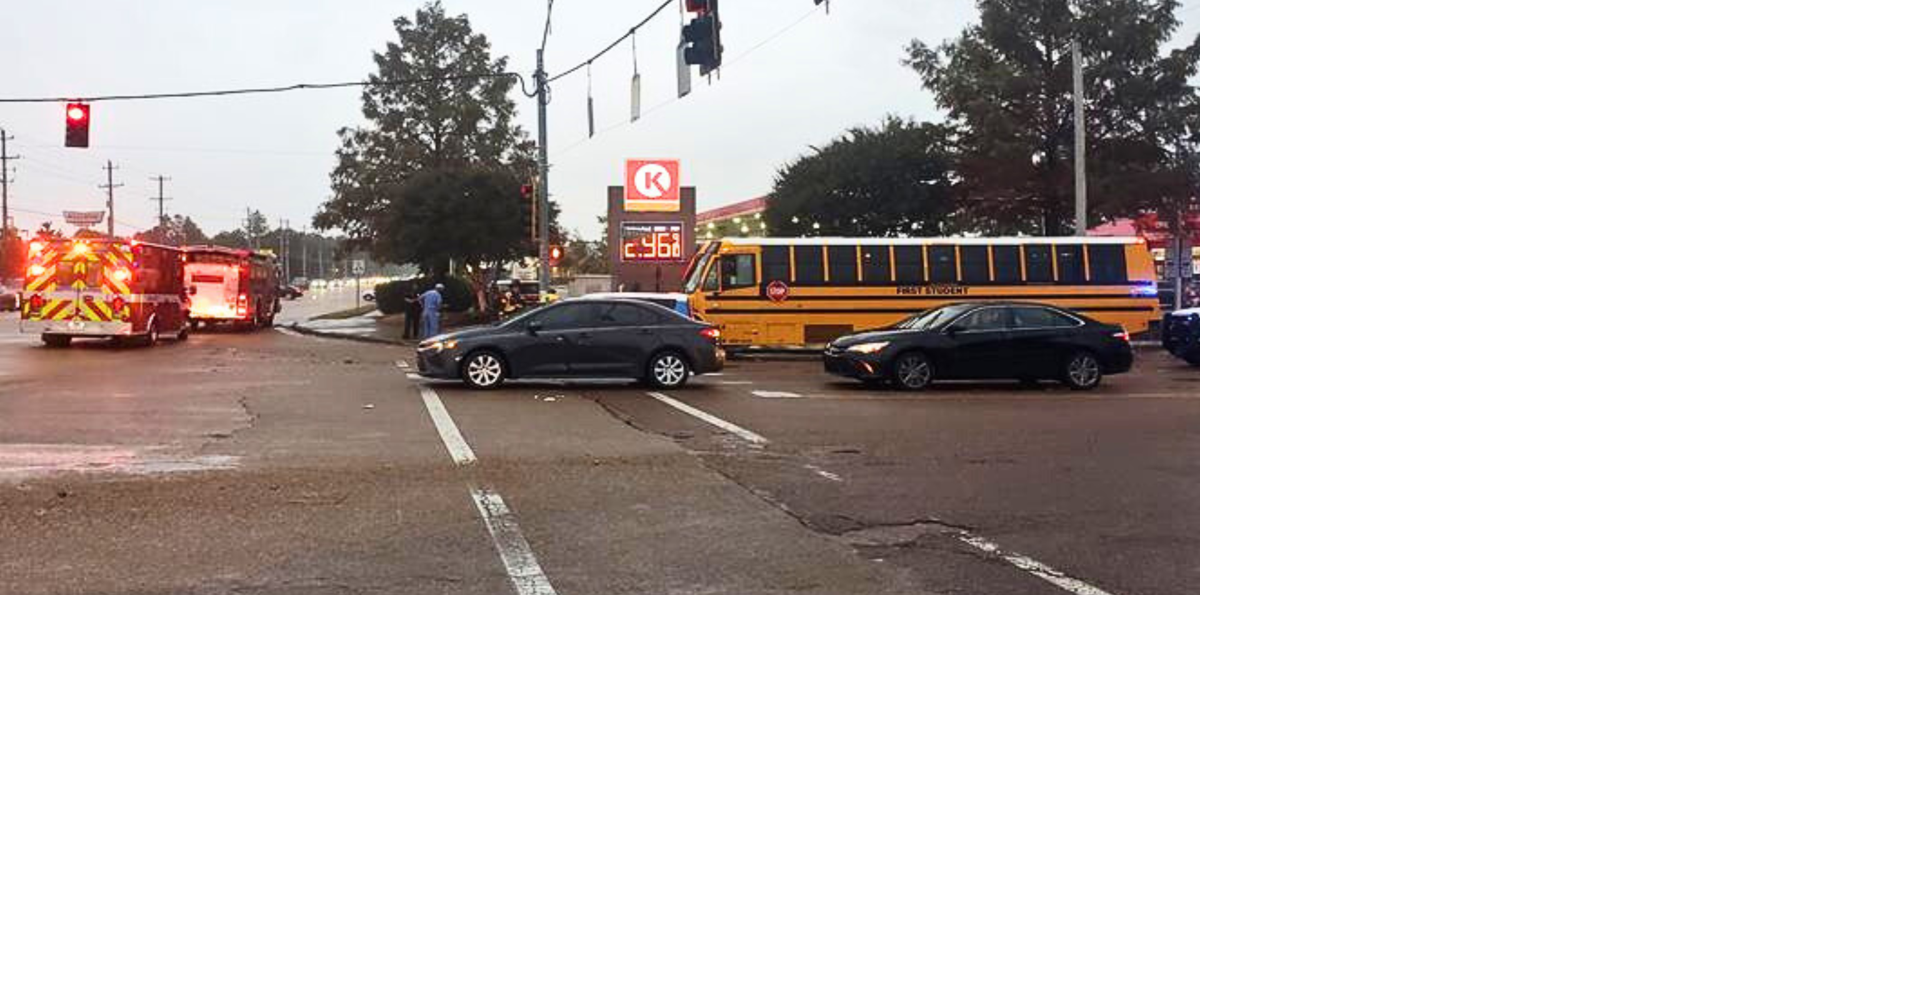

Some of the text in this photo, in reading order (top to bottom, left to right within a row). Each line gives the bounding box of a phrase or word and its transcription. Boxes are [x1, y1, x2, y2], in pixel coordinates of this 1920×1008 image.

[645, 172, 666, 194] K
[769, 286, 786, 295] STOP
[896, 286, 969, 295] FIRST STUDENT
